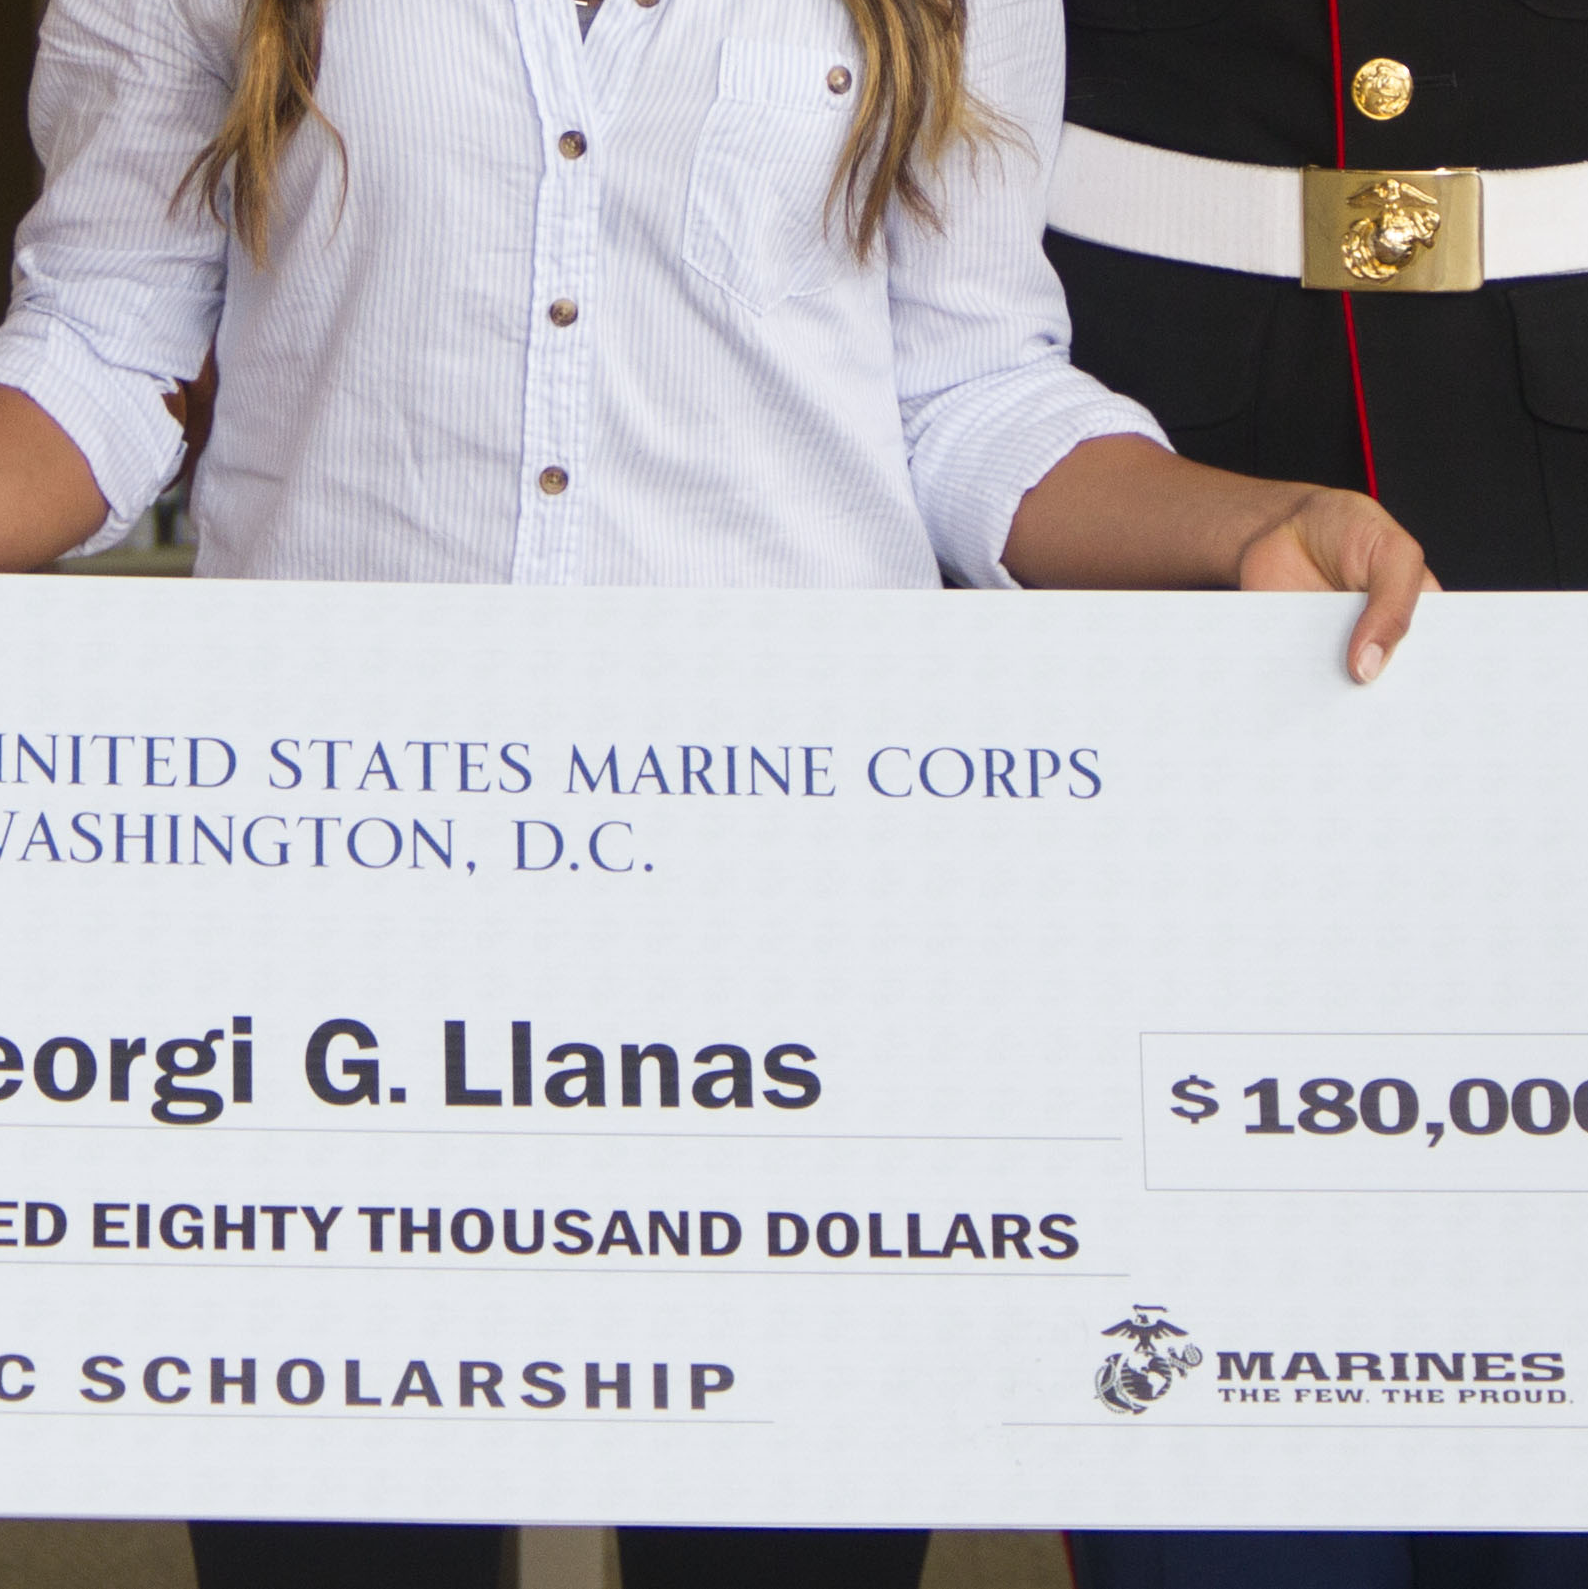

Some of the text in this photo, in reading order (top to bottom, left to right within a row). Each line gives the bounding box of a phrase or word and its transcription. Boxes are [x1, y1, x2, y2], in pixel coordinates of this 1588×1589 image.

[269, 738, 533, 794] STATES
[565, 743, 836, 797] MARINE
[867, 746, 1102, 800] CORPS
[512, 820, 654, 873] D.C.
[304, 1017, 407, 1107] G.
[443, 1019, 822, 1111] Llanas
[1170, 1074, 1220, 1125] $
[92, 1202, 344, 1253] EIGHTY
[357, 1206, 743, 1258] THOUSAND
[766, 1210, 1080, 1261] DOLLARS
[79, 1354, 735, 1411] SCHOLARSHIP
[1215, 1351, 1566, 1383] MARINES
[1217, 1387, 1576, 1405] THE FEW. THE PROUD.
